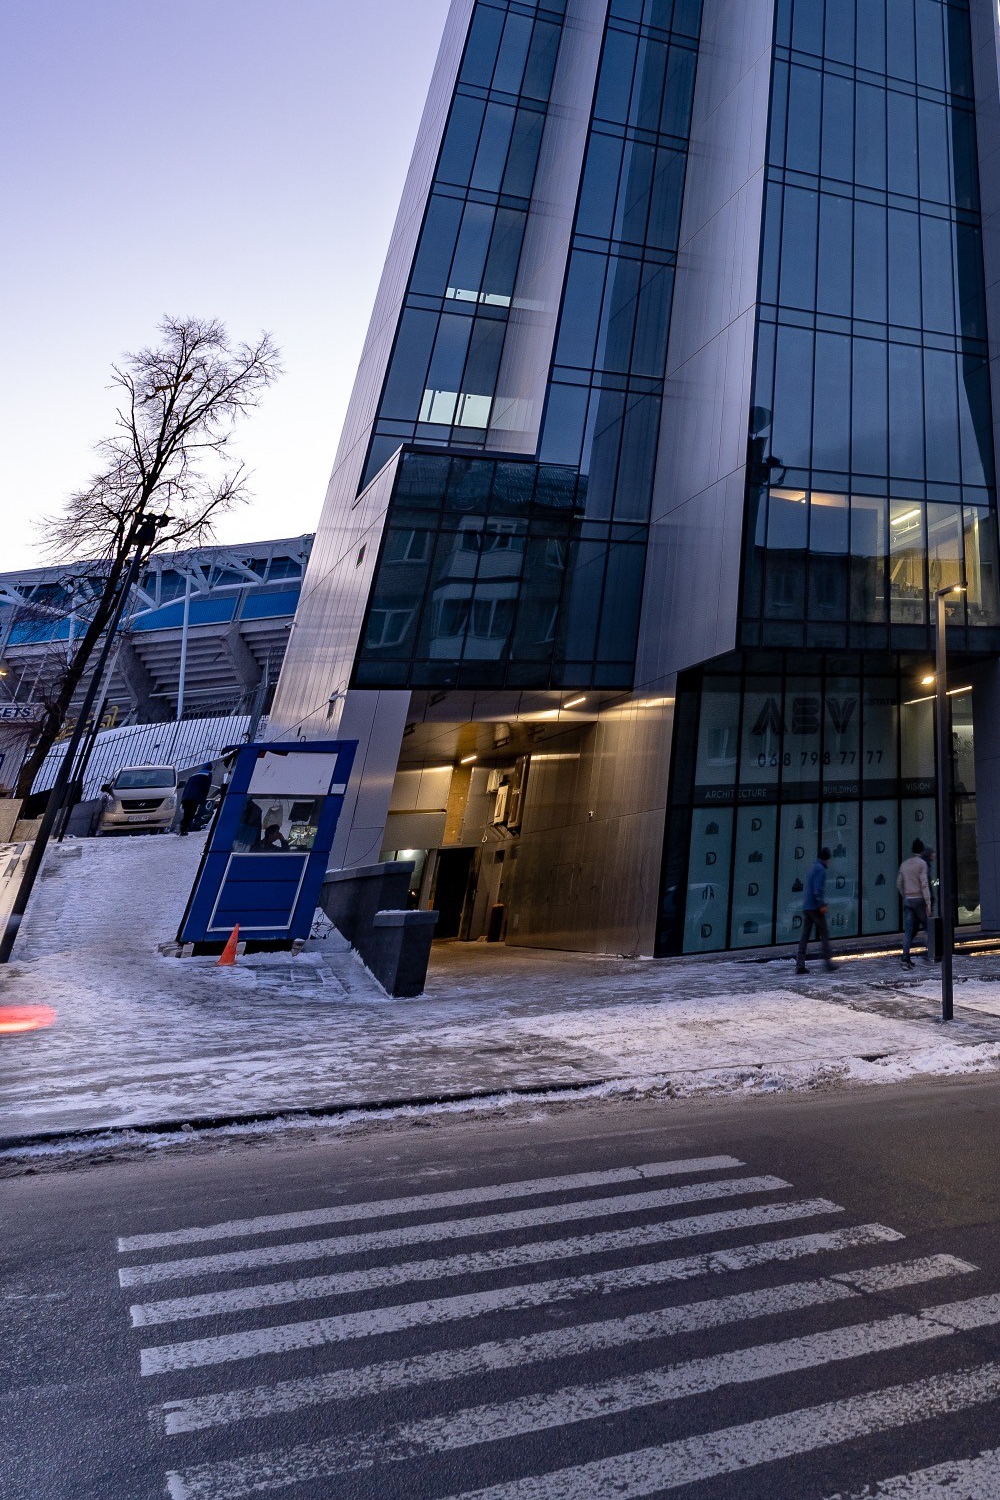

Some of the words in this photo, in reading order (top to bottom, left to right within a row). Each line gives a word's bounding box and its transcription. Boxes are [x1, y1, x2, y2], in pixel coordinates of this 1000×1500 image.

[757, 752, 791, 768] 068
[800, 751, 831, 767] 798
[839, 751, 856, 765] 77
[866, 750, 883, 764] 77
[705, 788, 767, 800] ARCHITECTURE
[823, 785, 858, 795] BUILDING
[905, 782, 931, 791] VISION
